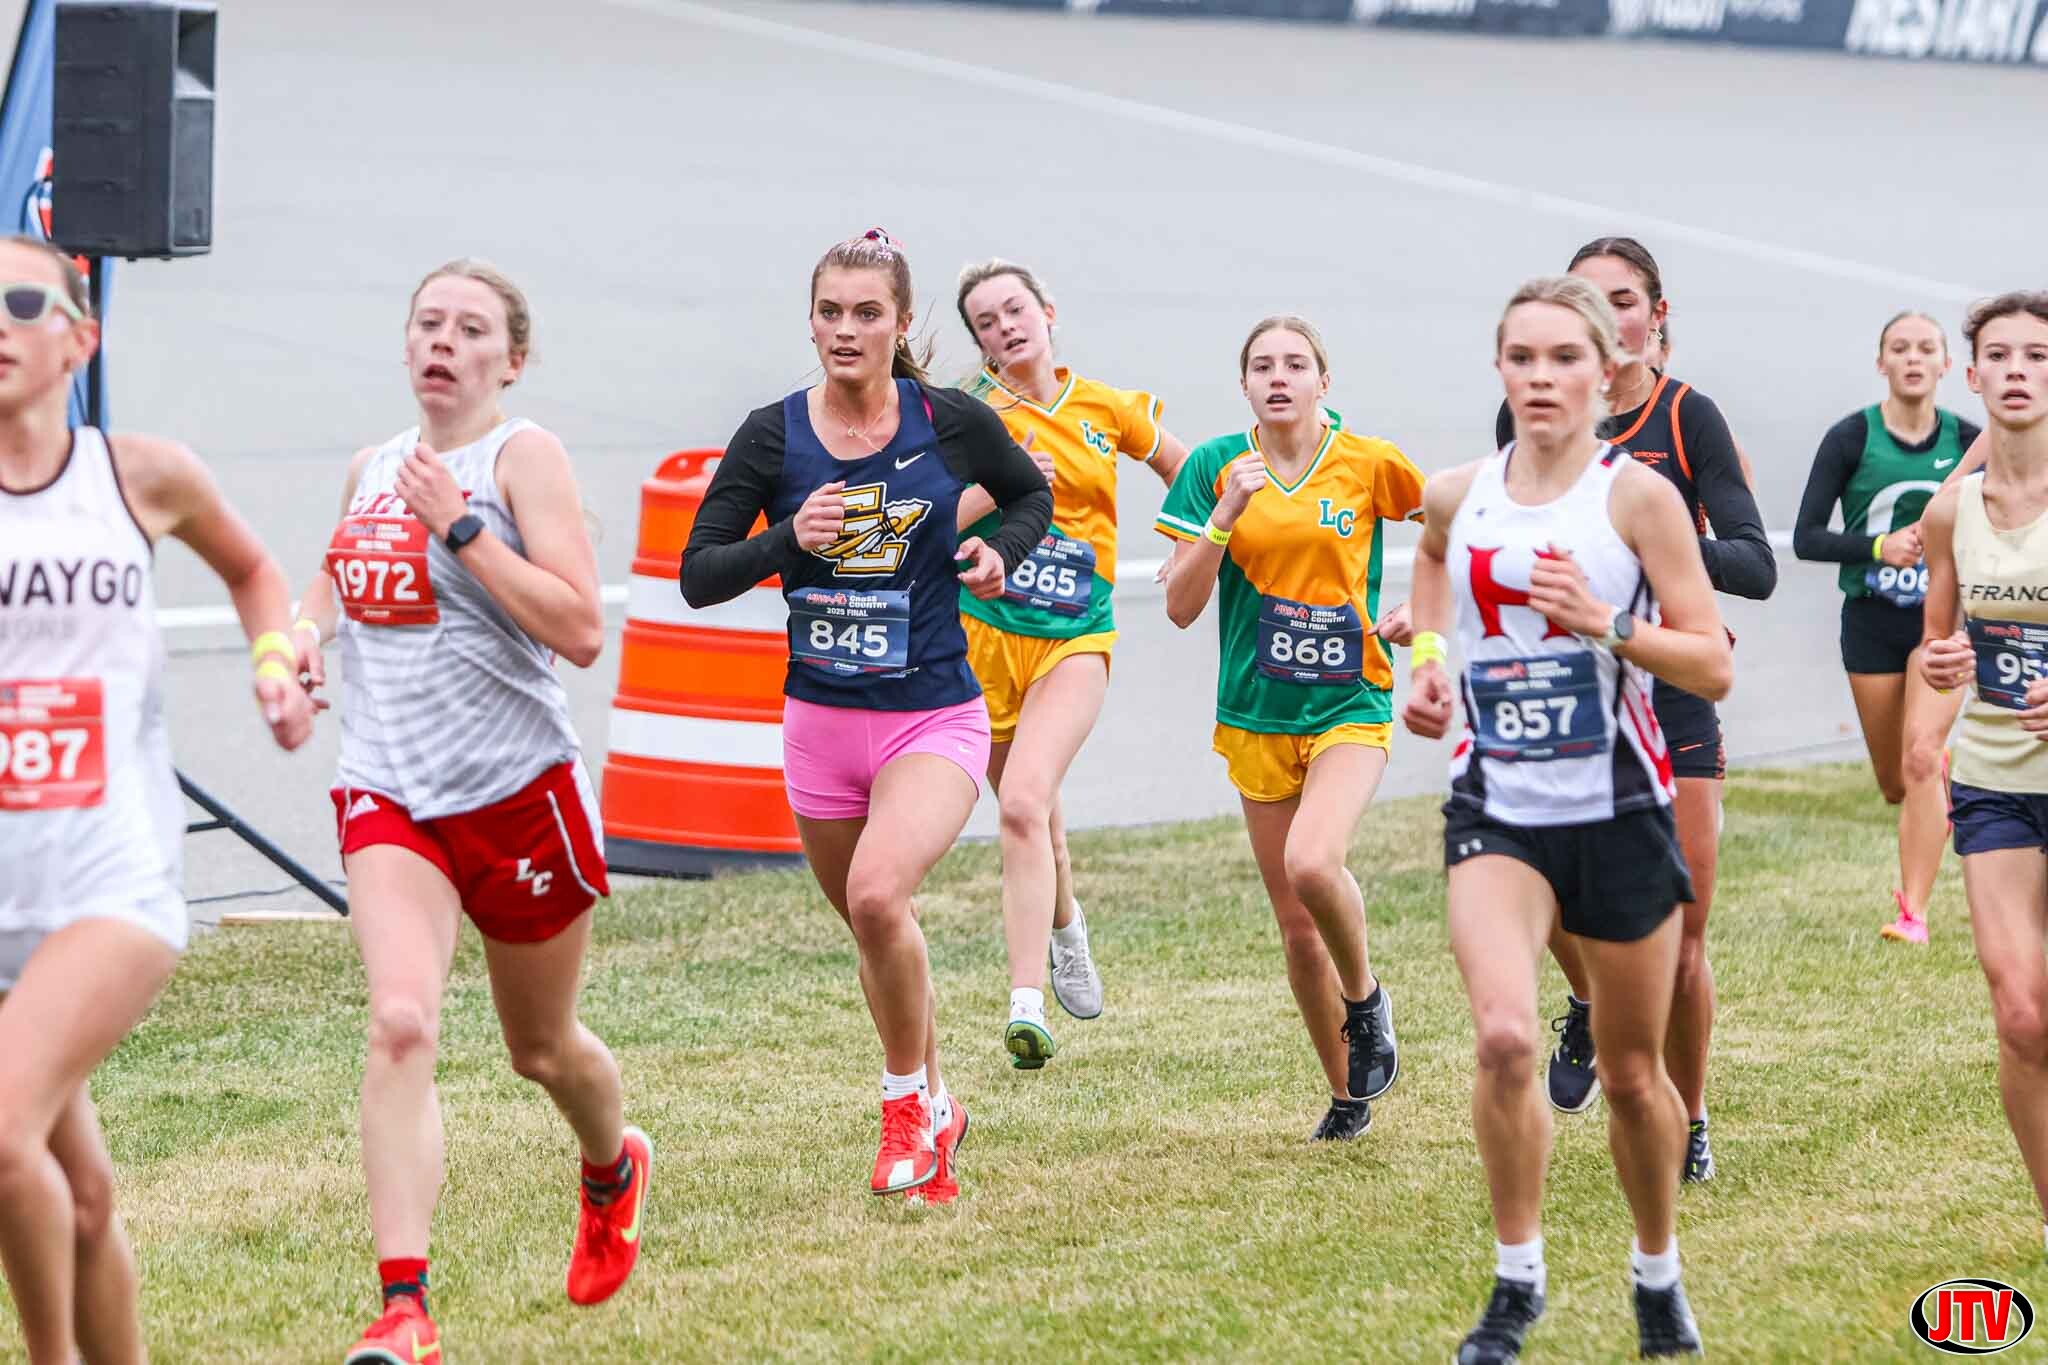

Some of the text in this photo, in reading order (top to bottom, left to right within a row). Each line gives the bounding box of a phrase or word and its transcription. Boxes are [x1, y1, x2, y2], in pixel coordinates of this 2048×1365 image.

[1080, 420, 1112, 455] LC
[1319, 498, 1354, 537] LC
[335, 559, 420, 600] 1972
[1012, 560, 1077, 597] 865
[847, 608, 869, 617] FINAL
[1308, 622, 1329, 631] FINAL
[809, 620, 889, 657] 845
[1270, 632, 1346, 666] 868
[1495, 696, 1578, 740] 857
[0, 729, 90, 781] 87
[516, 857, 554, 896] LC
